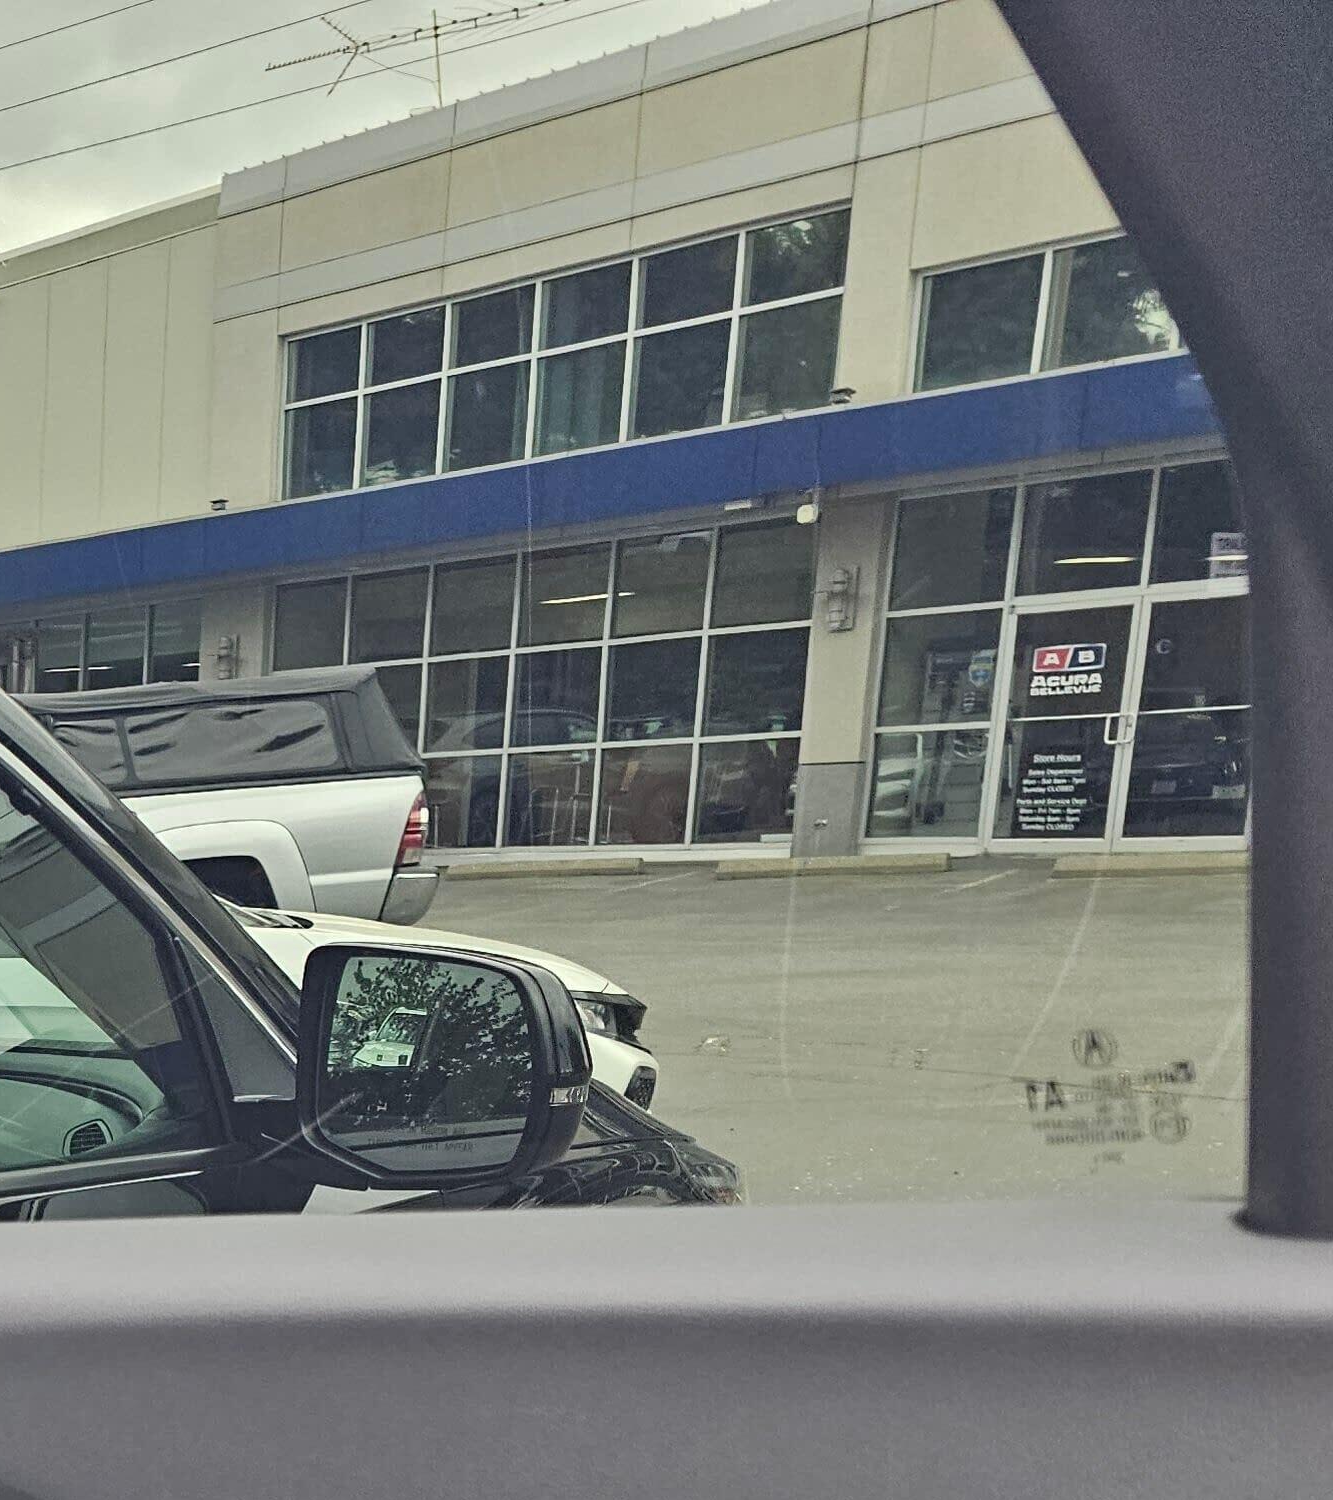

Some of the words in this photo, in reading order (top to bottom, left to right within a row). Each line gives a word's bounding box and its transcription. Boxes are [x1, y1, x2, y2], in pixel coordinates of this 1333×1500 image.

[1042, 653, 1060, 666] A
[1078, 650, 1095, 663] B
[1030, 672, 1103, 688] ACURA
[1030, 684, 1102, 696] BELLEVUE
